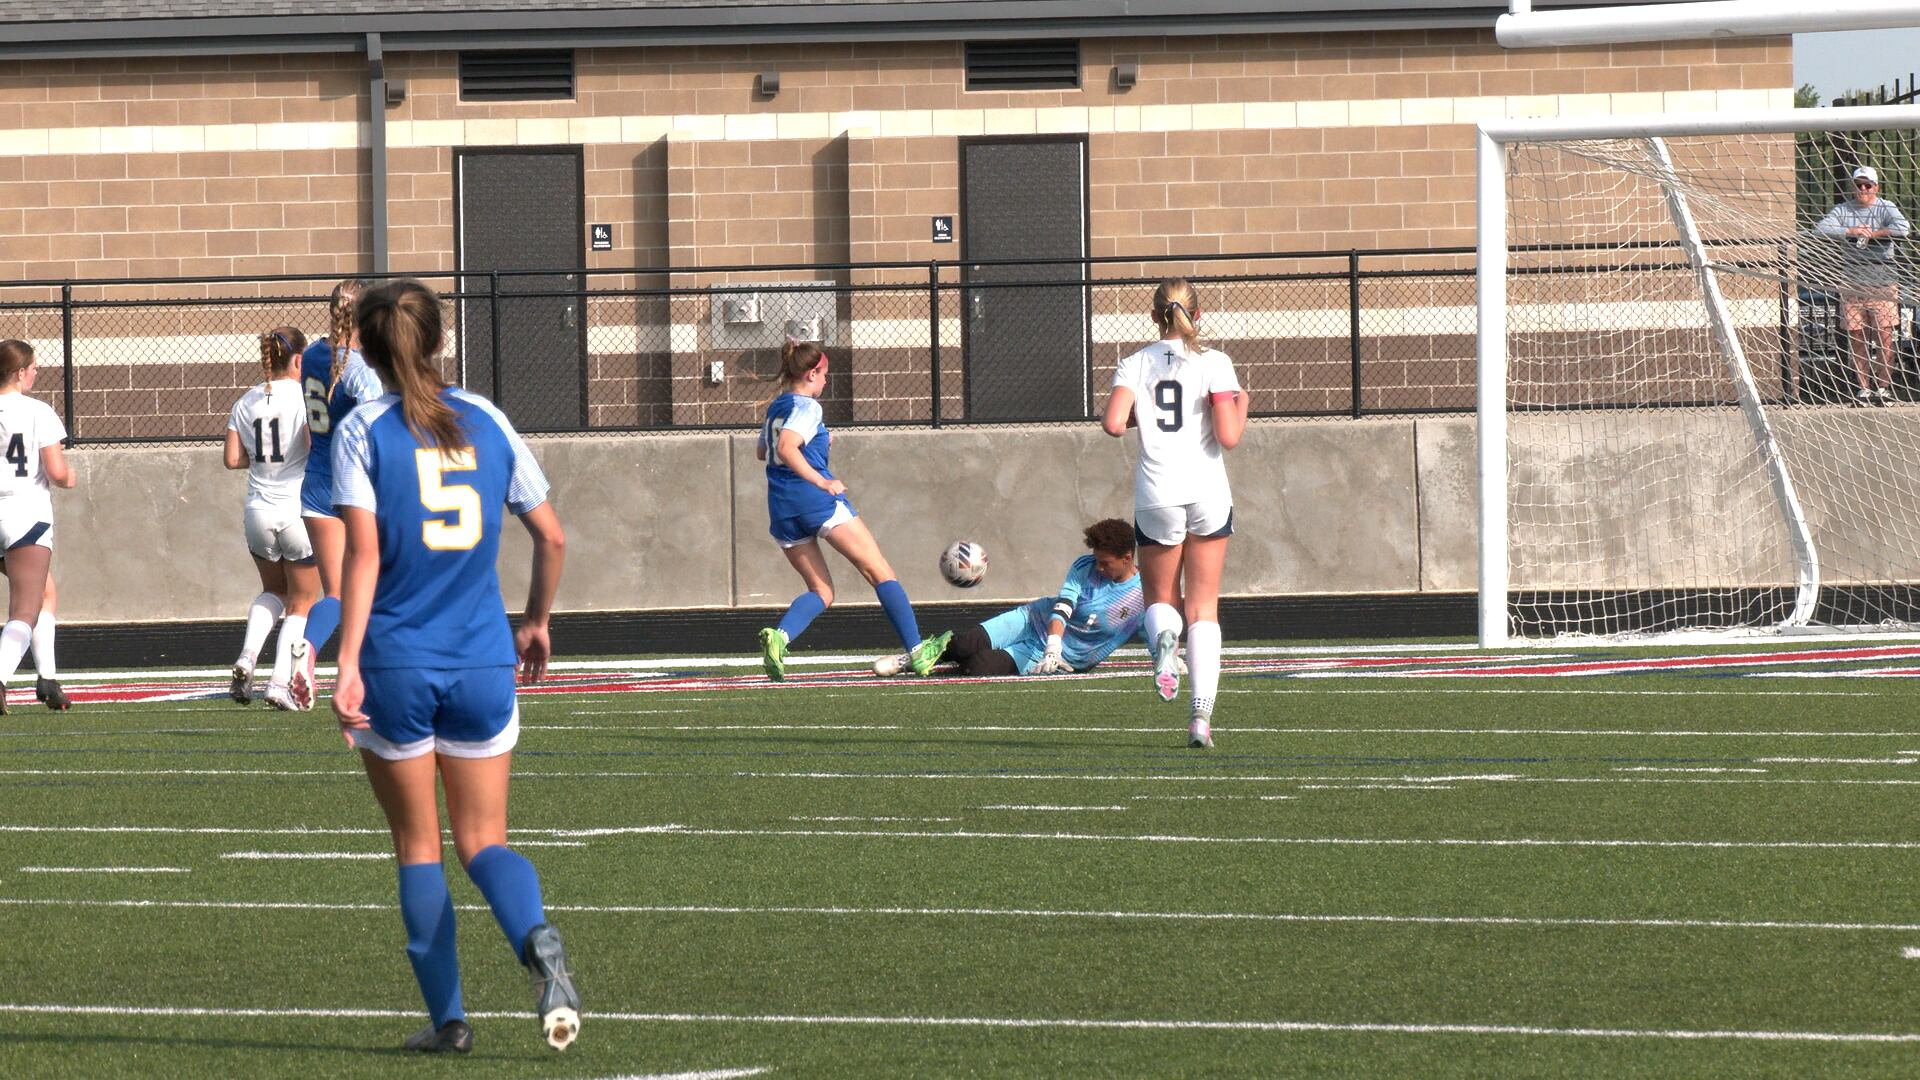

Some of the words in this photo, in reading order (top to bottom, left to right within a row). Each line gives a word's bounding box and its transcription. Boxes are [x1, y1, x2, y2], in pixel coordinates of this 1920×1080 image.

[304, 376, 330, 433] 6
[1154, 380, 1183, 432] 9
[6, 432, 28, 477] 4
[253, 417, 284, 463] 11
[415, 446, 483, 550] 5
